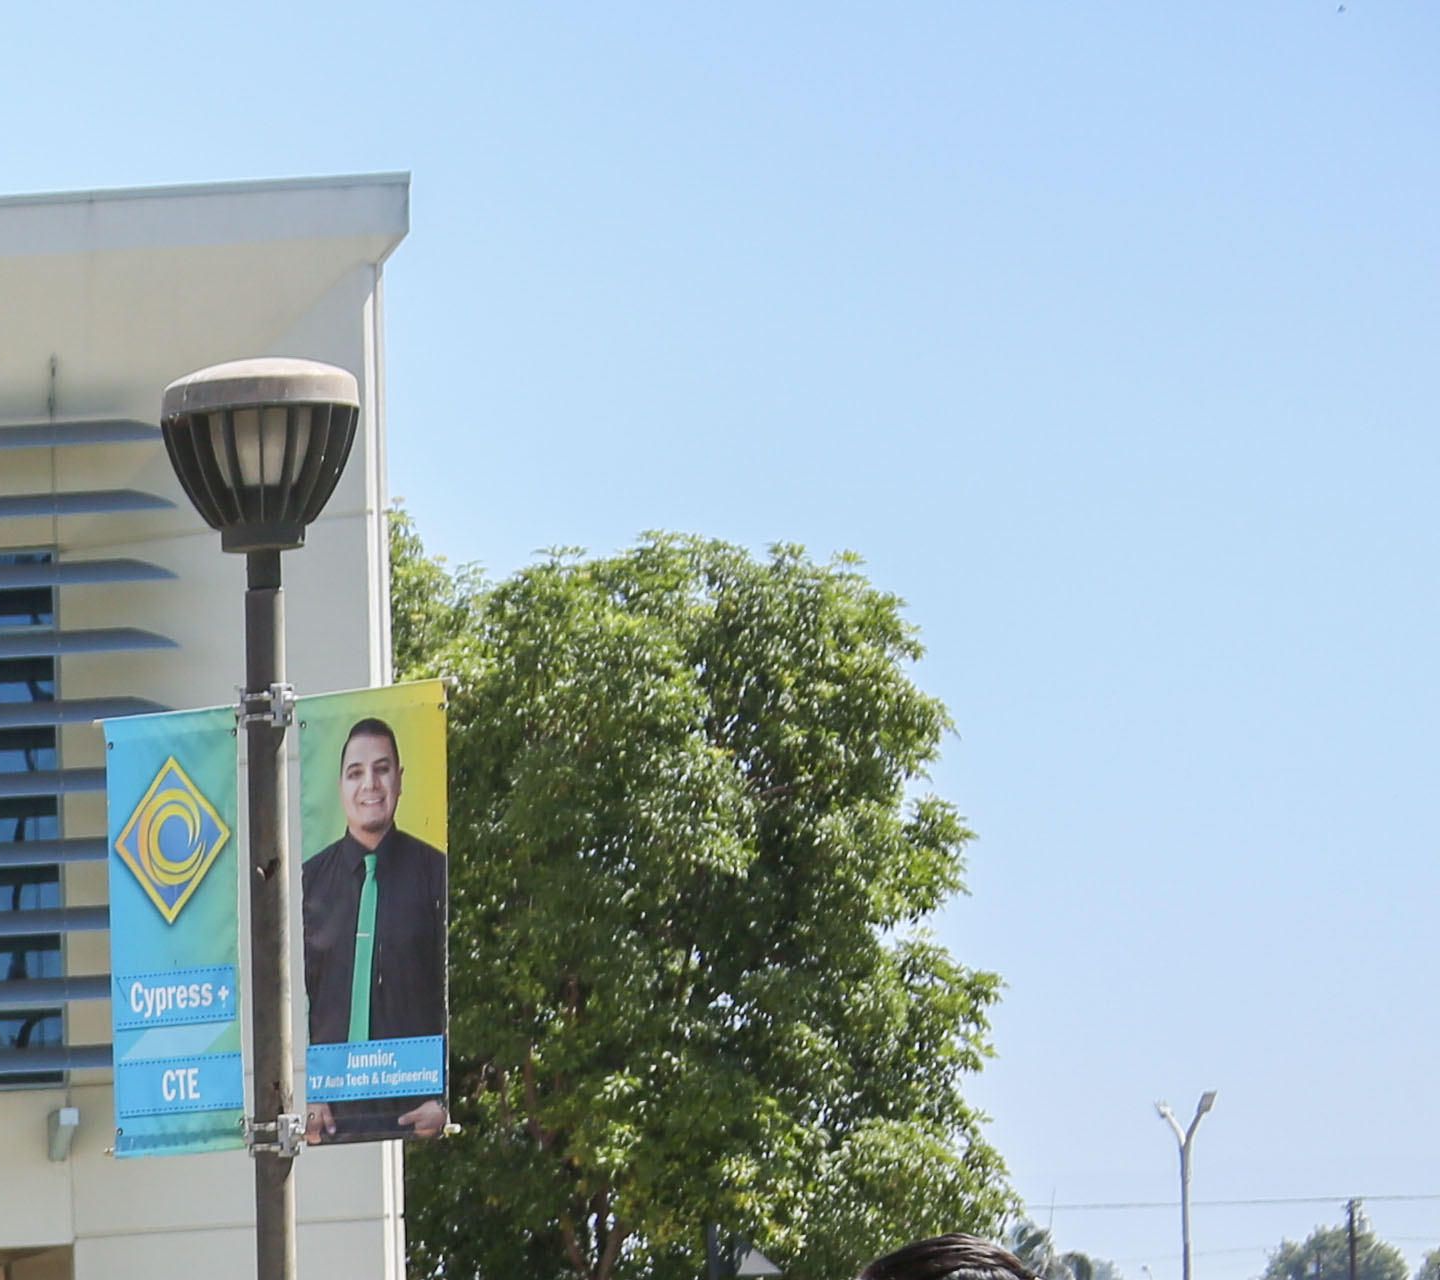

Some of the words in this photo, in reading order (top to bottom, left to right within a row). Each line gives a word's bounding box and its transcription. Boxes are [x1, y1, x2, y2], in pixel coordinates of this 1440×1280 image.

[130, 981, 213, 1018] Cypress
[346, 1049, 397, 1070] Junnior,
[162, 1067, 201, 1102] CTE
[325, 1075, 344, 1089] Auto
[346, 1072, 369, 1087] Tech
[371, 1071, 379, 1085] &
[381, 1066, 439, 1086] Engineering
